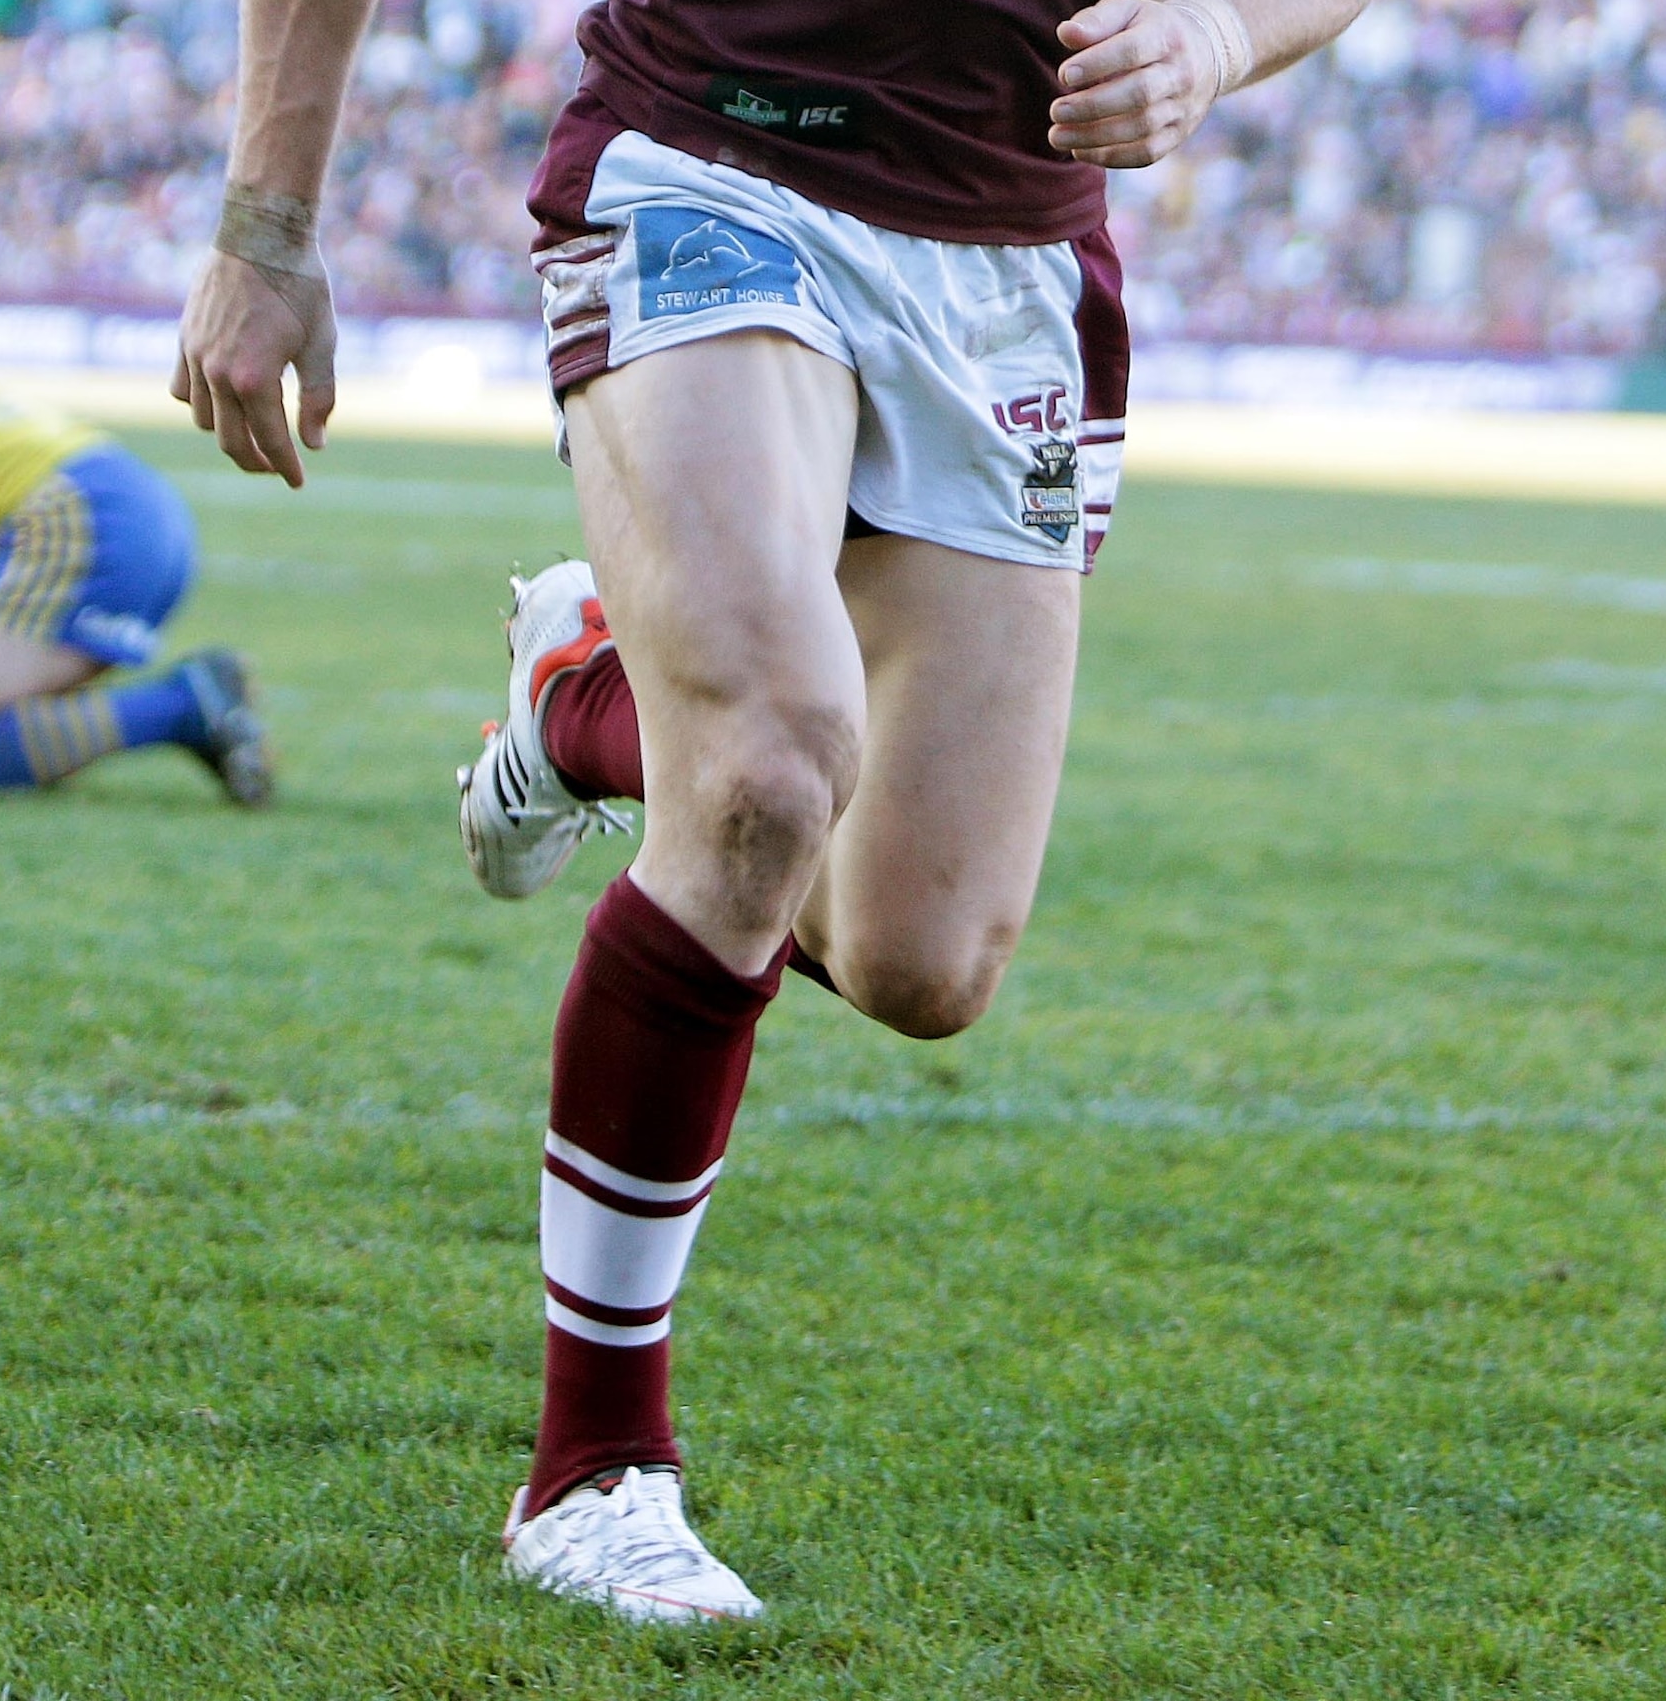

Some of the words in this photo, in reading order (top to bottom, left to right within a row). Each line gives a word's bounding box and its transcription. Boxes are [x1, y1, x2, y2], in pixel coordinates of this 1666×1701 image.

[798, 105, 849, 128] ISC
[656, 288, 731, 309] STEWART
[736, 288, 784, 304] HOUSE
[991, 386, 1066, 434] ISC
